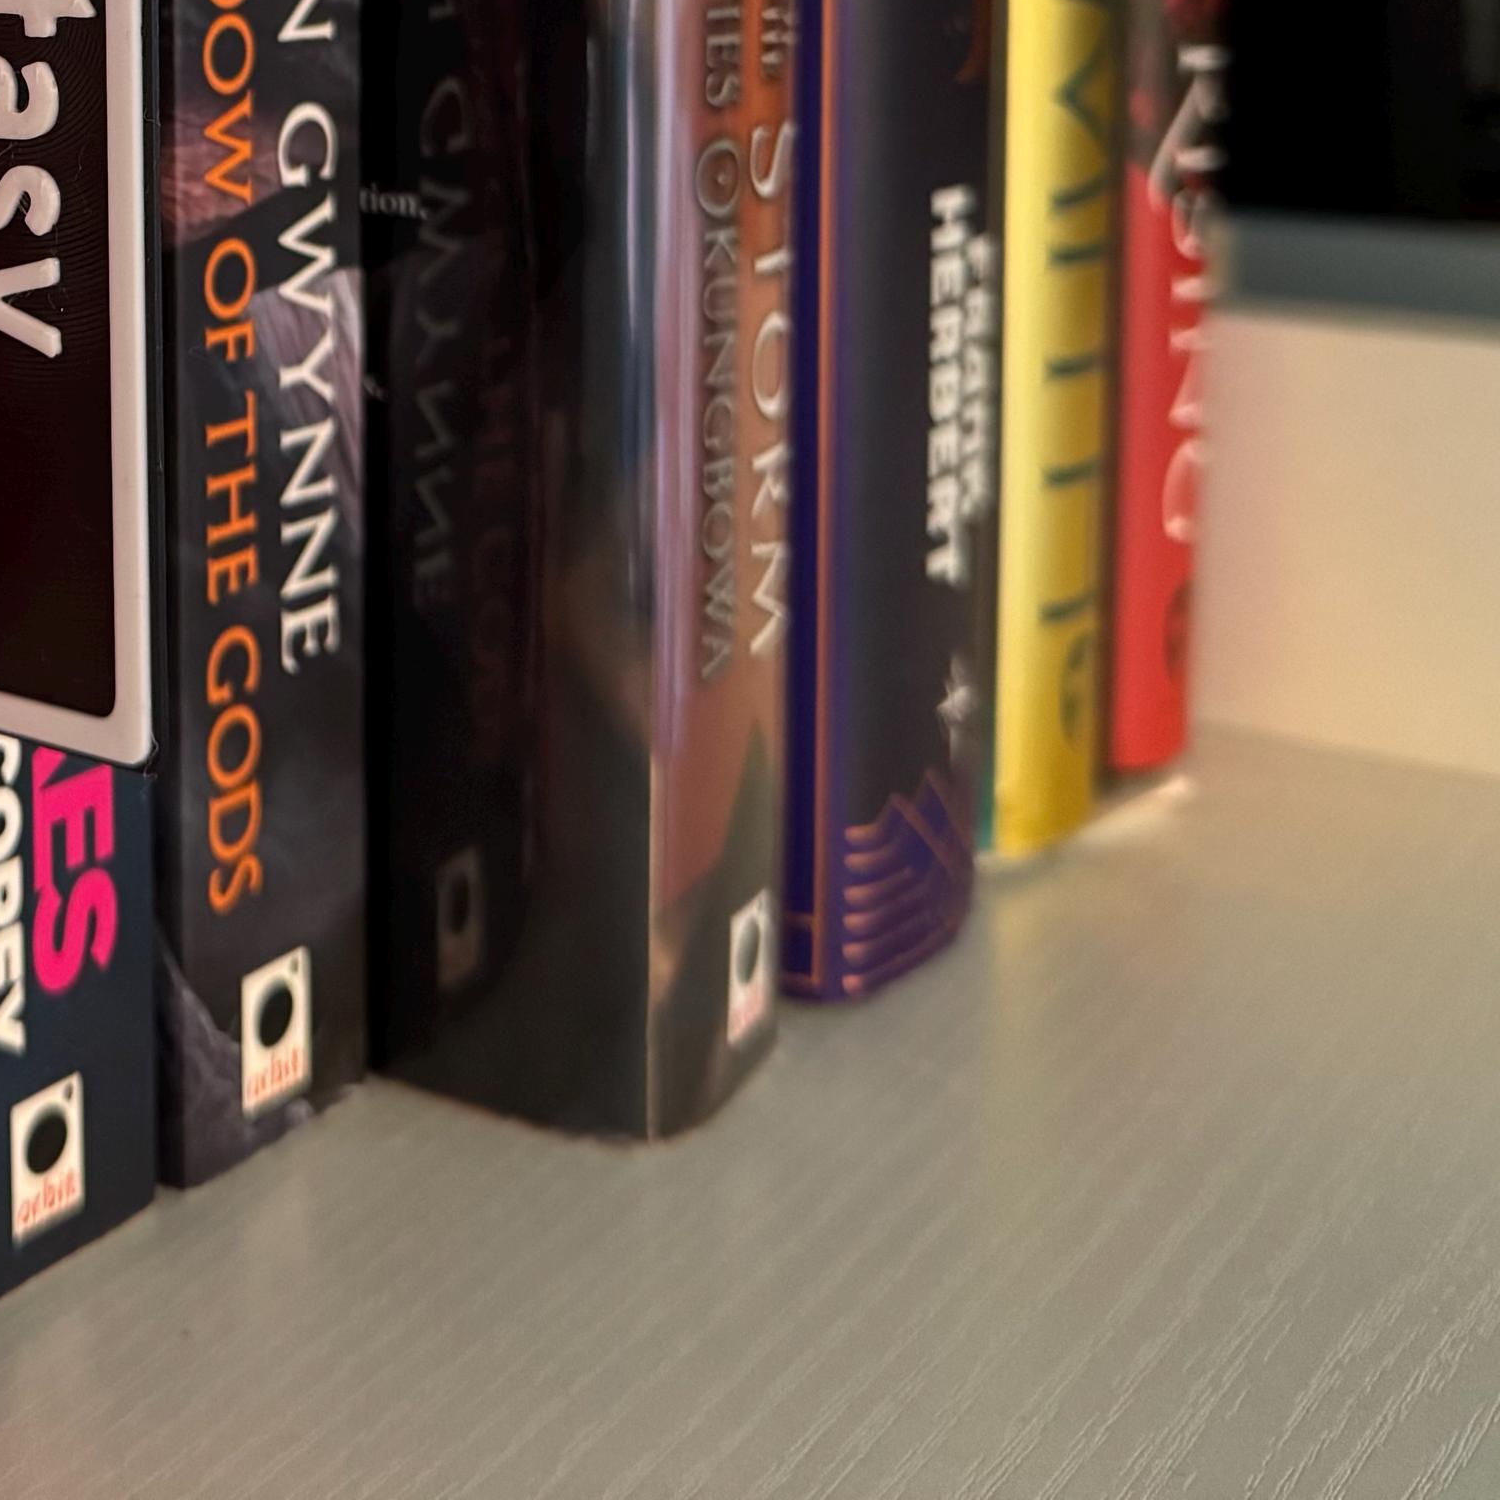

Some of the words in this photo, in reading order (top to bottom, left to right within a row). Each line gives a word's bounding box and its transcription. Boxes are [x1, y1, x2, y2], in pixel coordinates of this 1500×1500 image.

[204, 237, 256, 363] OF
[276, 101, 341, 676] GWYNNE
[926, 184, 978, 587] HERBERT
[205, 390, 258, 605] THE
[206, 624, 263, 916] GODS
